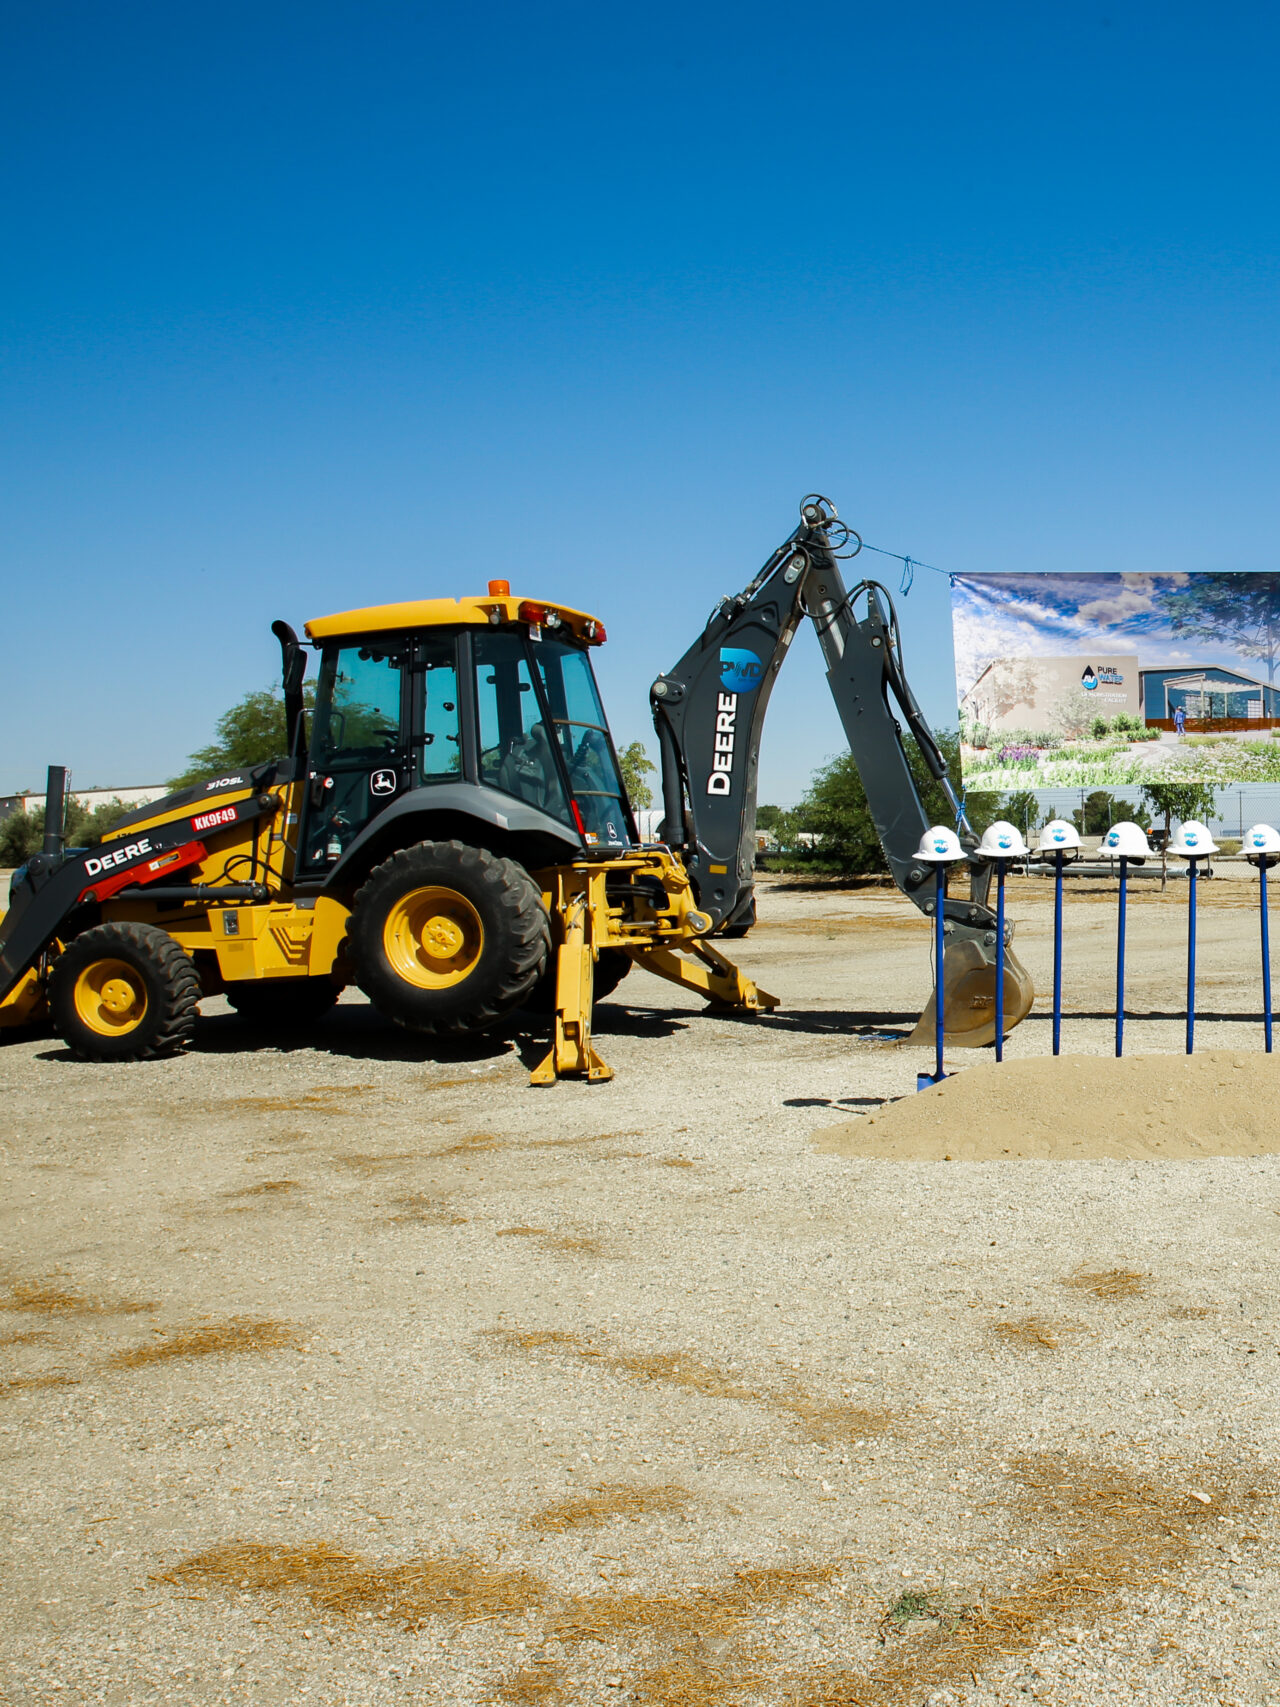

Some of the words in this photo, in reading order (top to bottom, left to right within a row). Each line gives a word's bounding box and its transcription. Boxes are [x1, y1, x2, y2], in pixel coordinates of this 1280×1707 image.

[1097, 665, 1118, 675] PURE
[707, 692, 738, 796] DEERE
[205, 776, 244, 791] 310SL
[194, 807, 236, 831] KK9F49
[84, 838, 153, 877] DEERE
